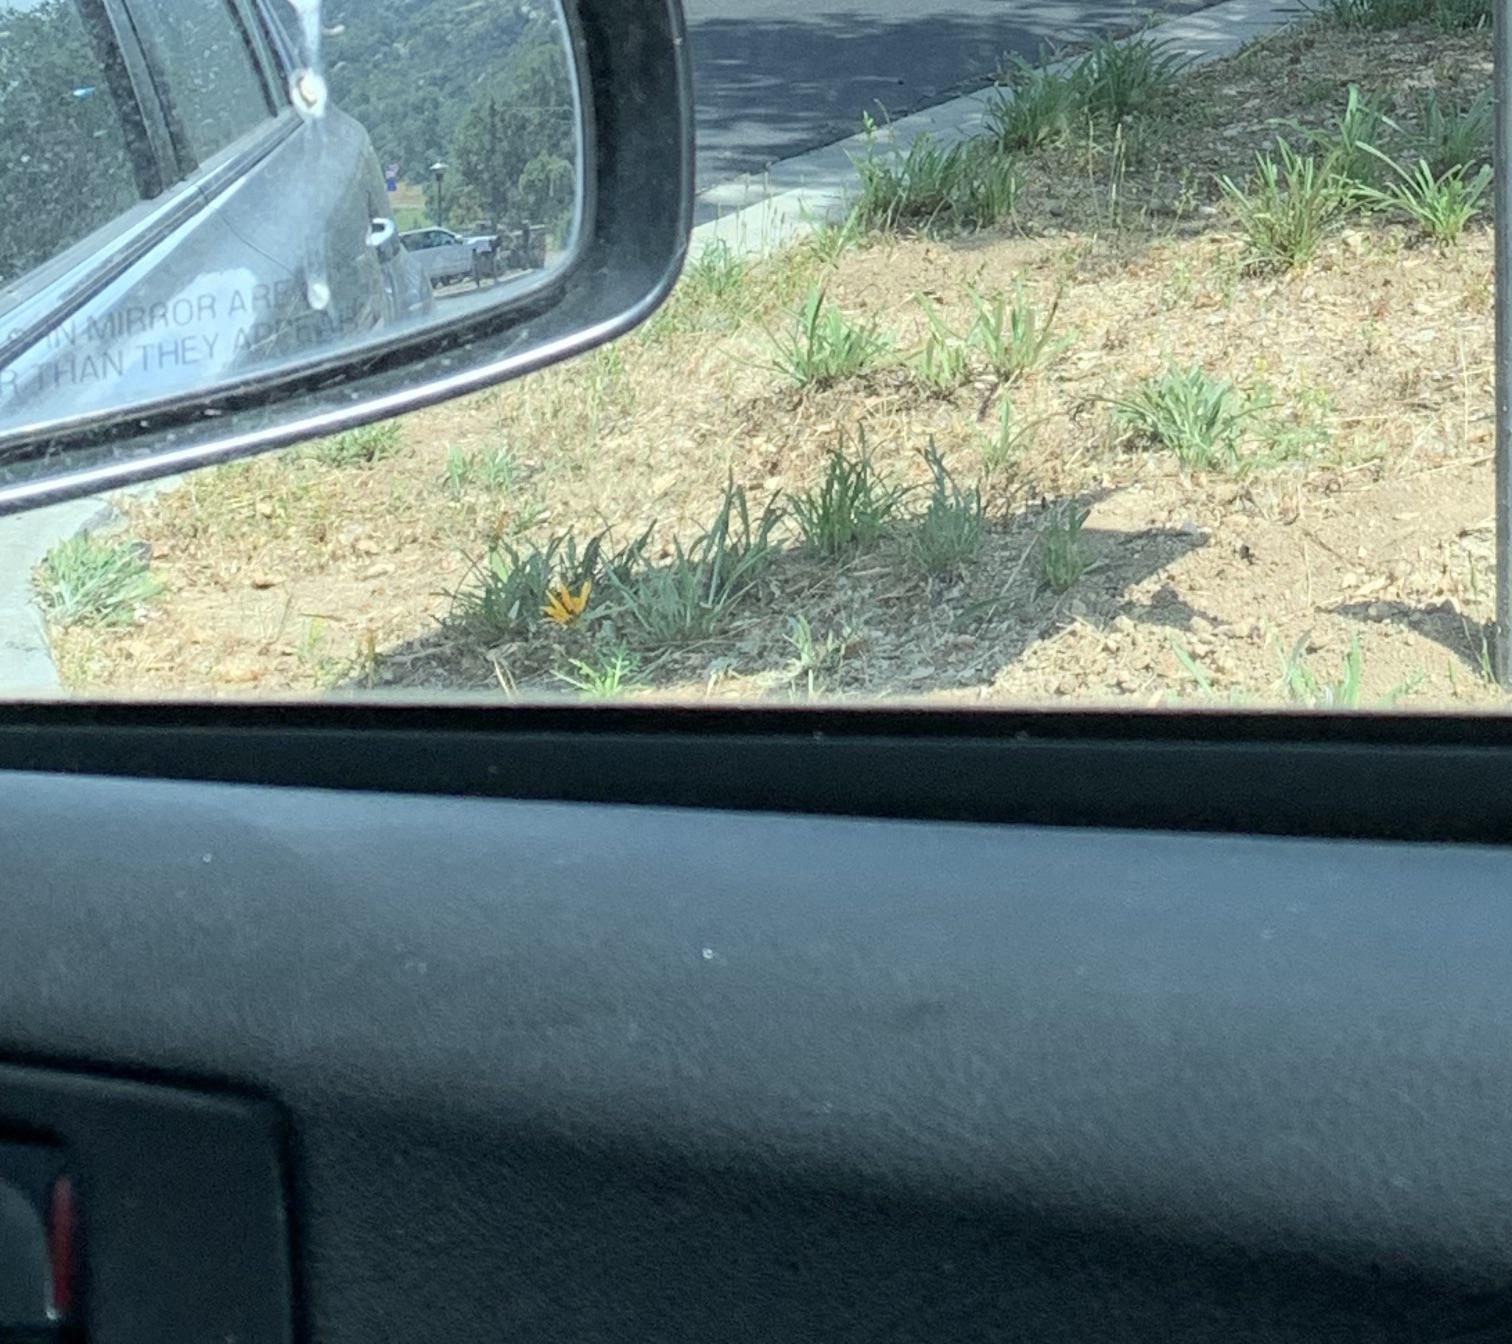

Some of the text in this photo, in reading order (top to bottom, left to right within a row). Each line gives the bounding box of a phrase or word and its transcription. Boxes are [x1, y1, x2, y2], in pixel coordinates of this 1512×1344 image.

[47, 319, 76, 348] IN
[87, 294, 217, 342] MIRROR
[229, 277, 294, 318] ARE
[33, 349, 124, 392] THAN
[136, 333, 218, 372] THEY
